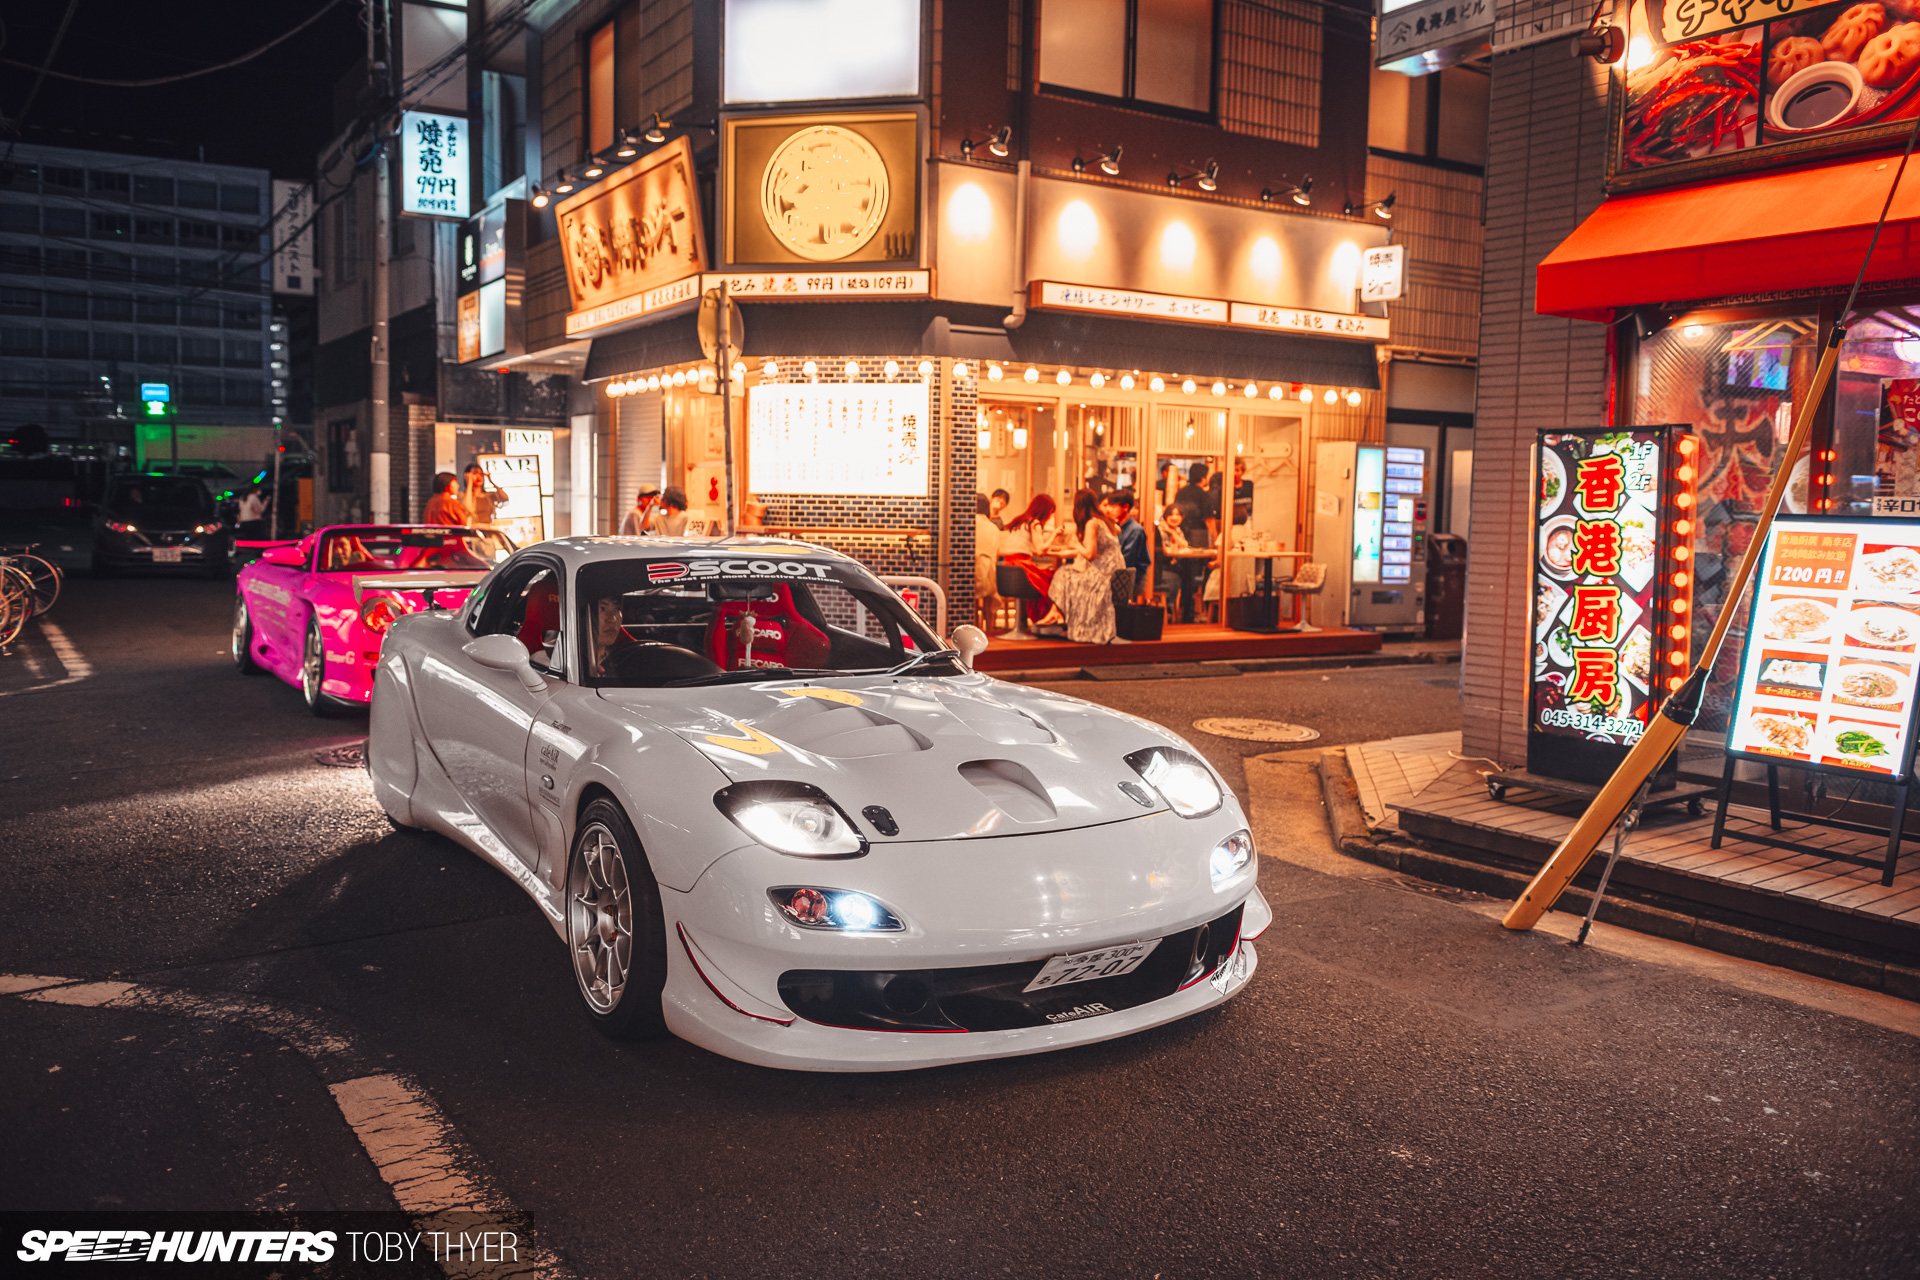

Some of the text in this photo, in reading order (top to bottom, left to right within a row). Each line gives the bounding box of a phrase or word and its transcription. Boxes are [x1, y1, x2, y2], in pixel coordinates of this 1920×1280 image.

[806, 277, 834, 290] 99円
[1629, 441, 1653, 461] 1F
[485, 458, 531, 472] BAR
[1626, 471, 1652, 491] 2F
[1883, 498, 1920, 513] 辛口
[1569, 452, 1625, 705] 香港厨房
[1543, 710, 1643, 736] 045-314-3271
[1106, 948, 1135, 960] 300
[1051, 955, 1143, 985] 72-07
